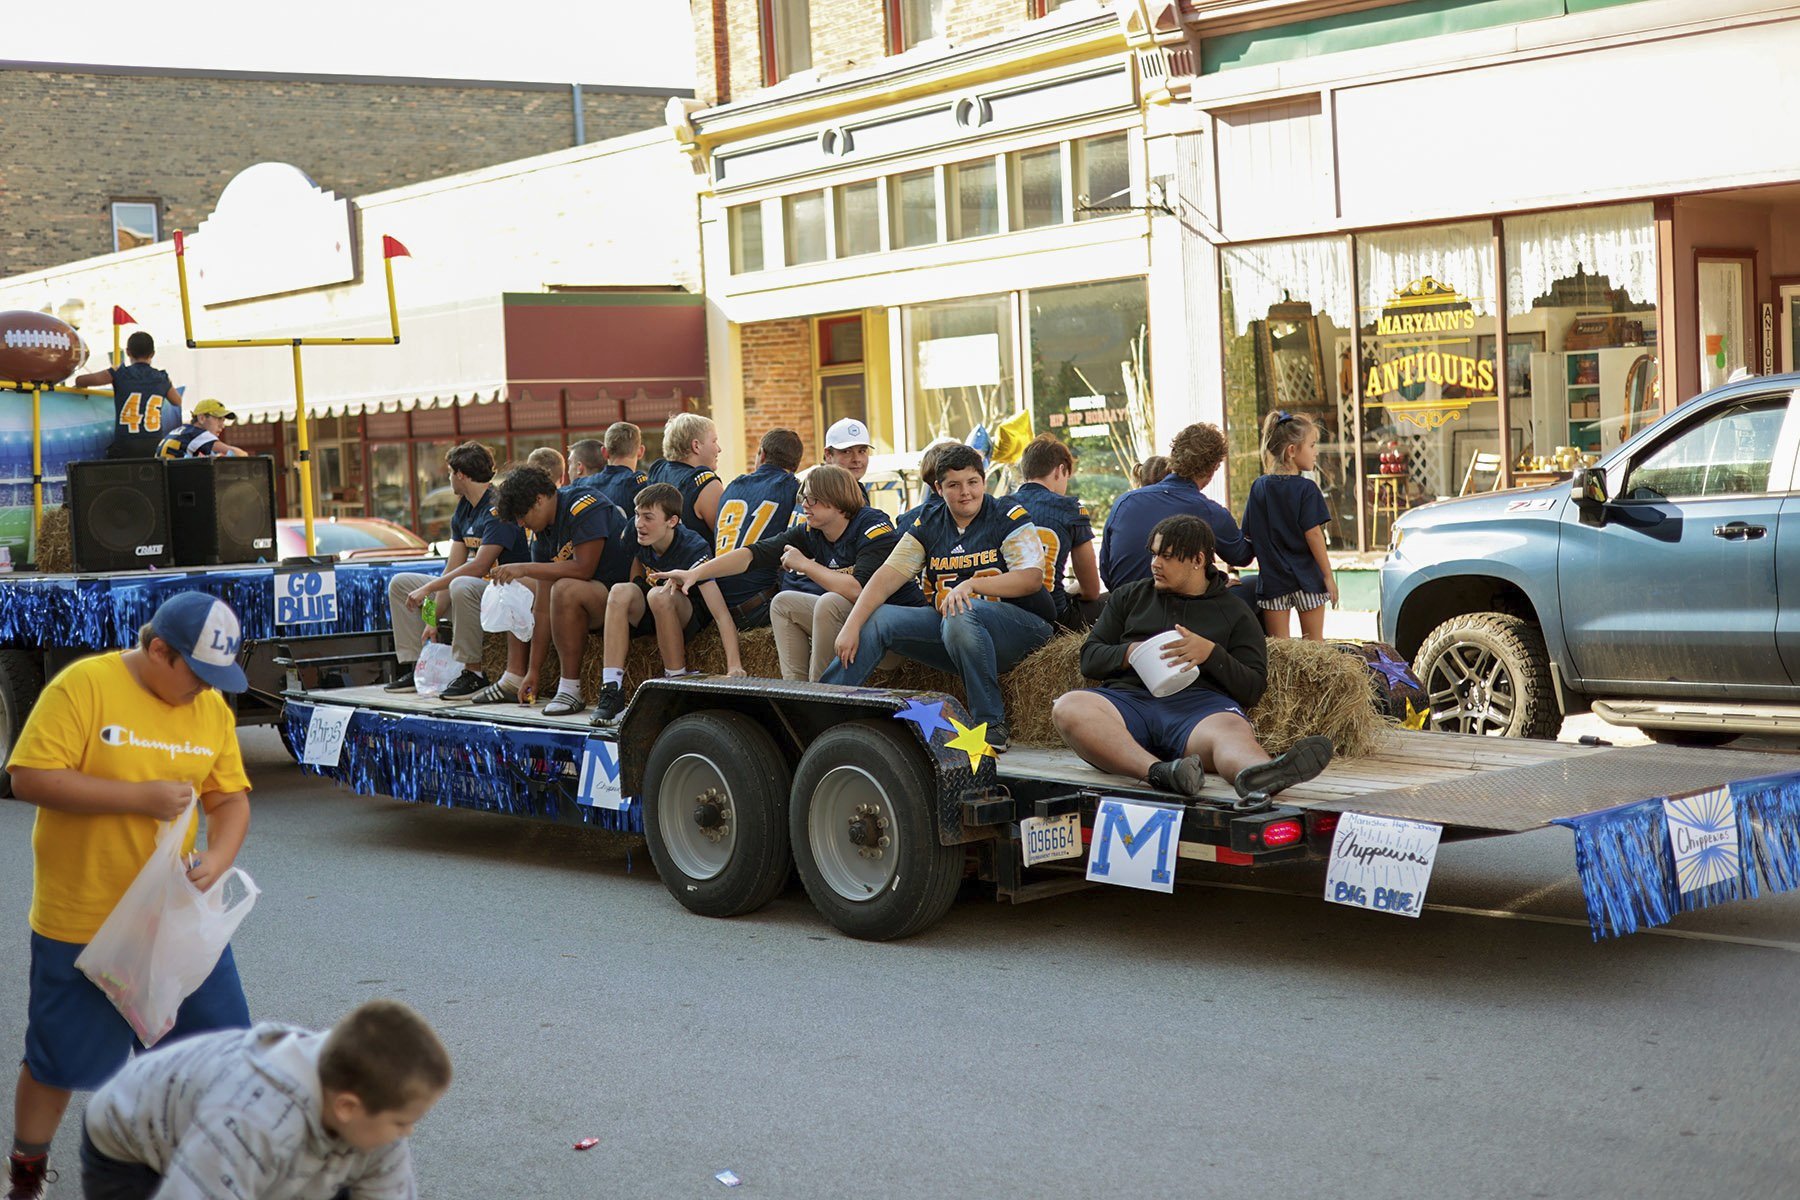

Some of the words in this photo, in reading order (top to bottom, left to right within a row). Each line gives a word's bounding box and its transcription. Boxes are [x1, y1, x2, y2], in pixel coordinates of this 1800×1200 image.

[1376, 309, 1475, 335] MARYANN'S
[1365, 351, 1496, 397] ANTIQUES
[120, 392, 163, 433] 46
[715, 499, 779, 558] 81
[135, 544, 164, 556] CRATE
[930, 549, 998, 570] MANISTEE
[287, 571, 322, 597] GO
[278, 594, 336, 623] BLUE
[99, 724, 214, 760] Champion
[1091, 801, 1179, 884] M
[1337, 830, 1429, 866] Chippewas
[1334, 881, 1367, 906] BIG
